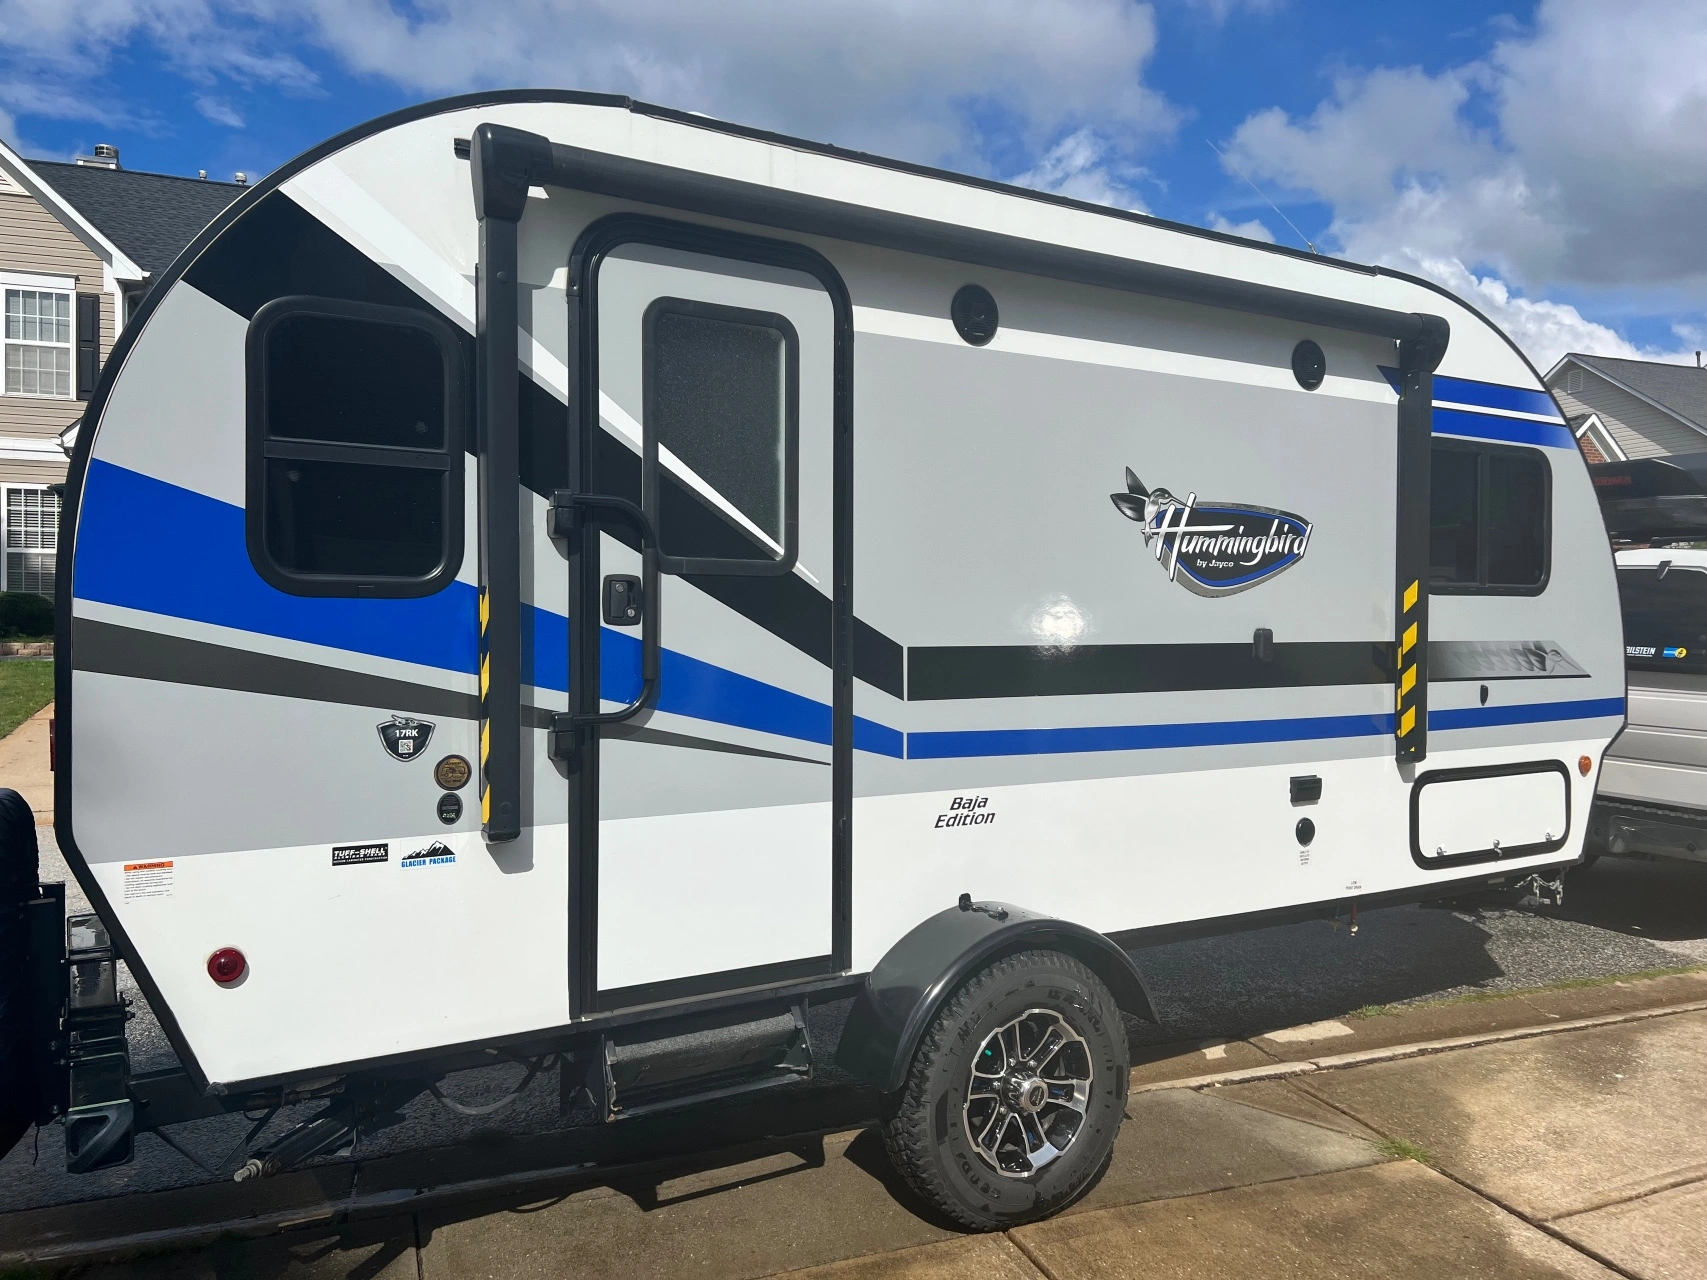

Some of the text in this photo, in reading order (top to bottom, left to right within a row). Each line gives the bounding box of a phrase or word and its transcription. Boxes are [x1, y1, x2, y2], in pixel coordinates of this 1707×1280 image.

[1141, 491, 1314, 583] Hummingbird
[1196, 558, 1235, 569] by Jayco
[394, 728, 419, 738] 17RK
[949, 795, 989, 813] Baja
[934, 811, 996, 829] Edition
[333, 847, 385, 857] TUFF-SHELL
[401, 855, 457, 868] GLACIER PACKAGE
